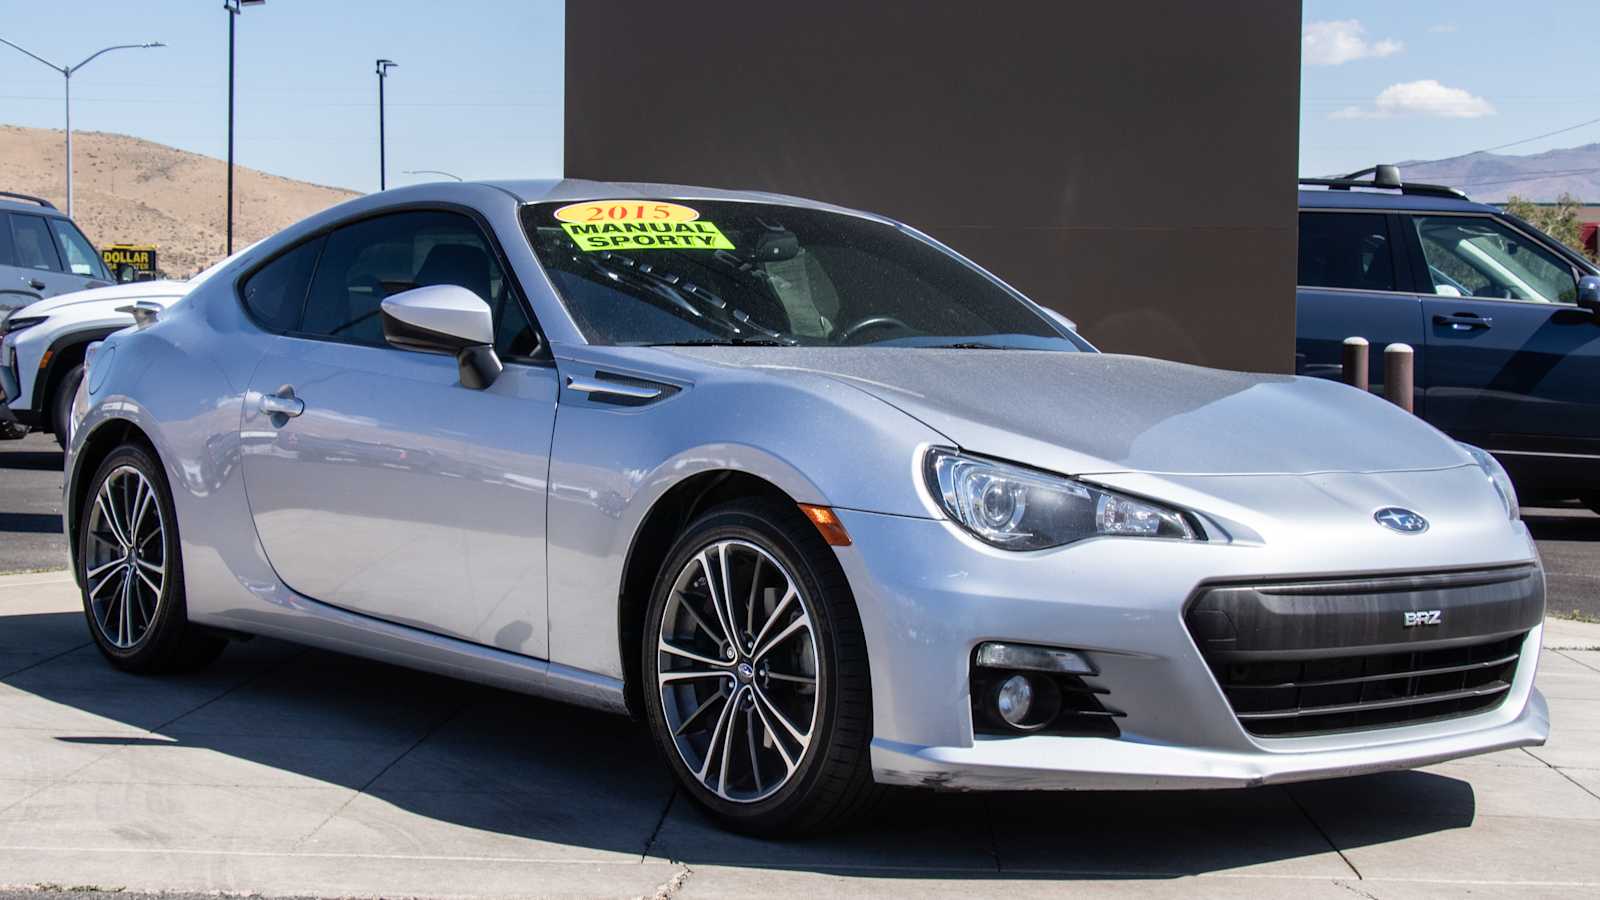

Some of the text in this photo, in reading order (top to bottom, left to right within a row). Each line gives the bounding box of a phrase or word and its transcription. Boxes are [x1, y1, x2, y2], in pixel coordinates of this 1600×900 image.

[587, 205, 671, 222] 2015
[570, 223, 716, 235] MANUAL
[587, 235, 717, 247] SPORTY
[103, 251, 148, 263] DOLLAR
[1404, 610, 1441, 626] BRZ
